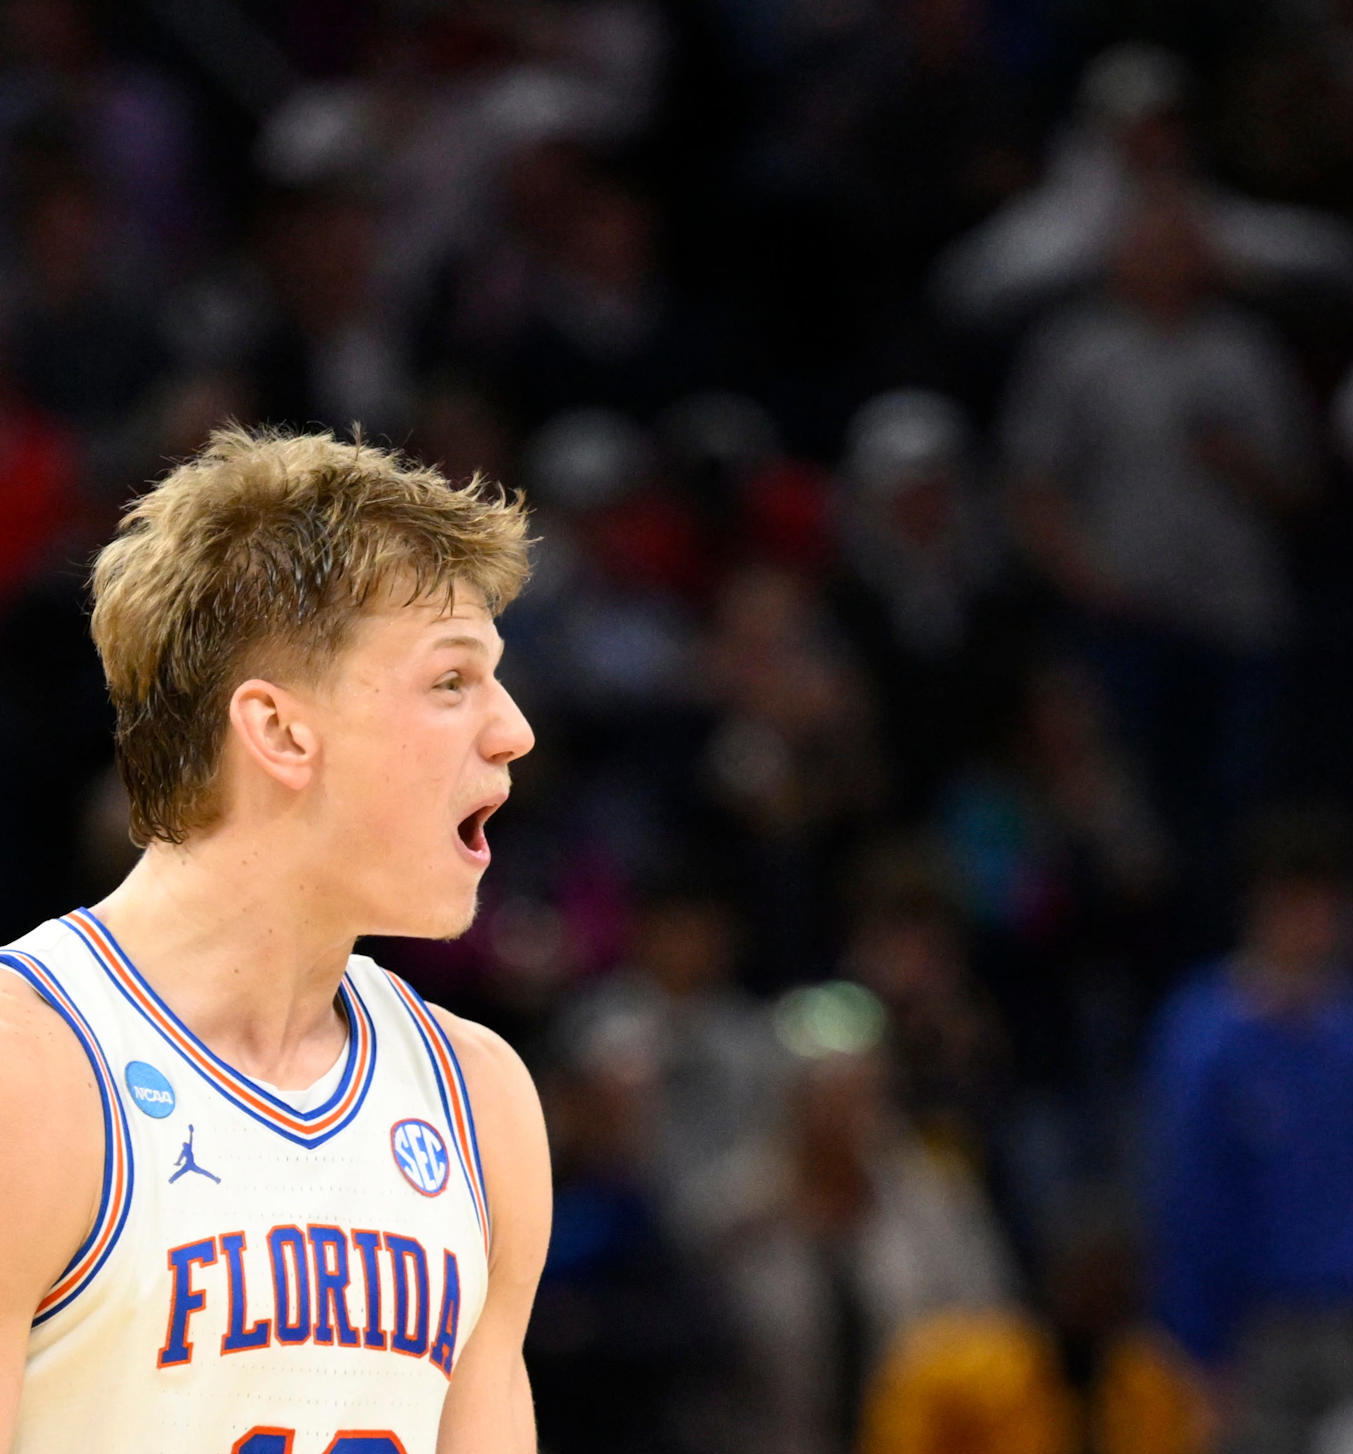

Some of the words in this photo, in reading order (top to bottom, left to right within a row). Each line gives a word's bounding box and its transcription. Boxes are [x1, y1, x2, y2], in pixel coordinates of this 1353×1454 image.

[133, 1085, 174, 1104] NCAA
[393, 1123, 447, 1191] SEC
[157, 1223, 461, 1381] FLORIDA
